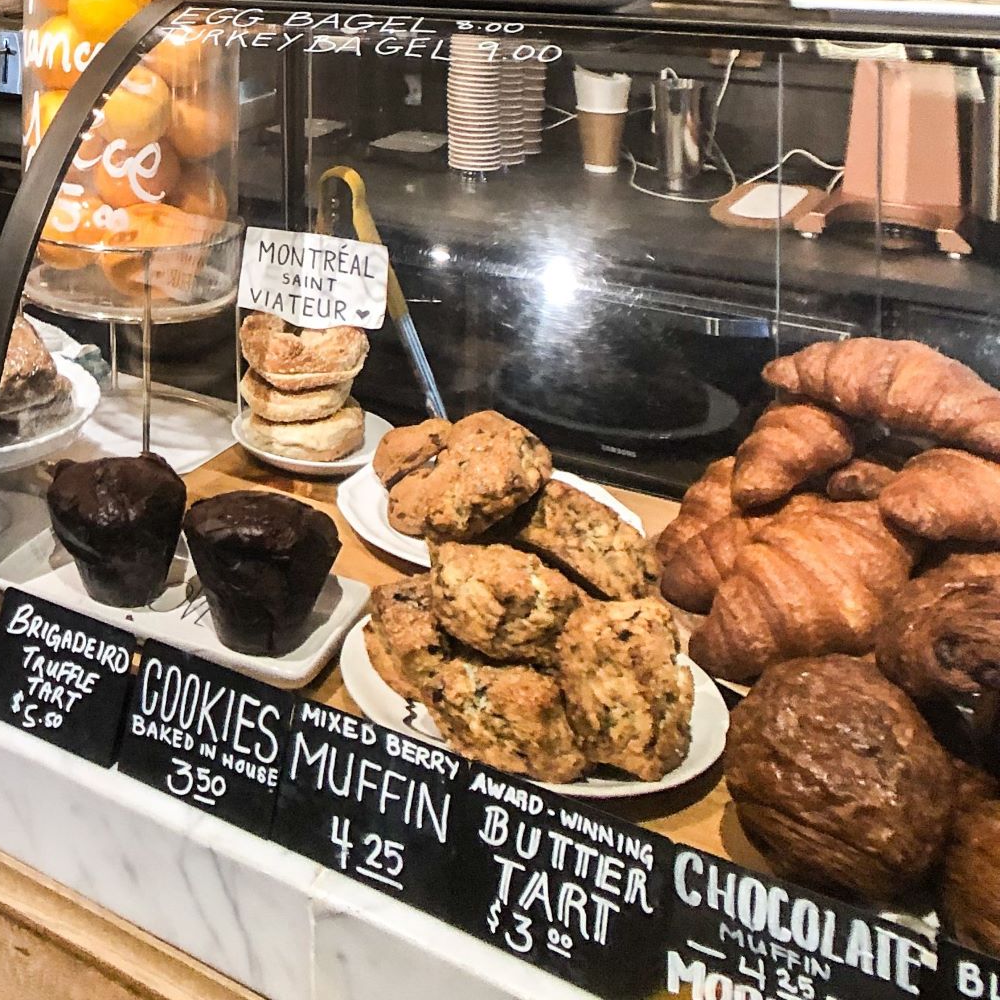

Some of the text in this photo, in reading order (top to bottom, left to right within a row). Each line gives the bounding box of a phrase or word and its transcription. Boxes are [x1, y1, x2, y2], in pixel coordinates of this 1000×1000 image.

[159, 26, 304, 53] TURKEY
[478, 41, 563, 63] 9.00
[170, 7, 264, 28] EGG
[284, 11, 438, 34] BAGEL
[258, 240, 375, 279] MONTRÉAL
[282, 272, 338, 292] SAINT
[250, 287, 348, 322] VIATEUR
[6, 602, 130, 675] BRIGADEIRO
[22, 645, 100, 695] TRUFFLE
[28, 675, 82, 713] TART
[141, 657, 281, 765] COOKIES
[131, 714, 279, 788] BAKED IN HOUSE
[301, 702, 460, 780] MIXED BERRY
[289, 731, 451, 845] MUFFIN
[478, 804, 654, 914] BUTTER
[492, 854, 620, 946] TART
[673, 850, 929, 996] CHOCOLATE
[719, 921, 831, 982] MUFFIN
